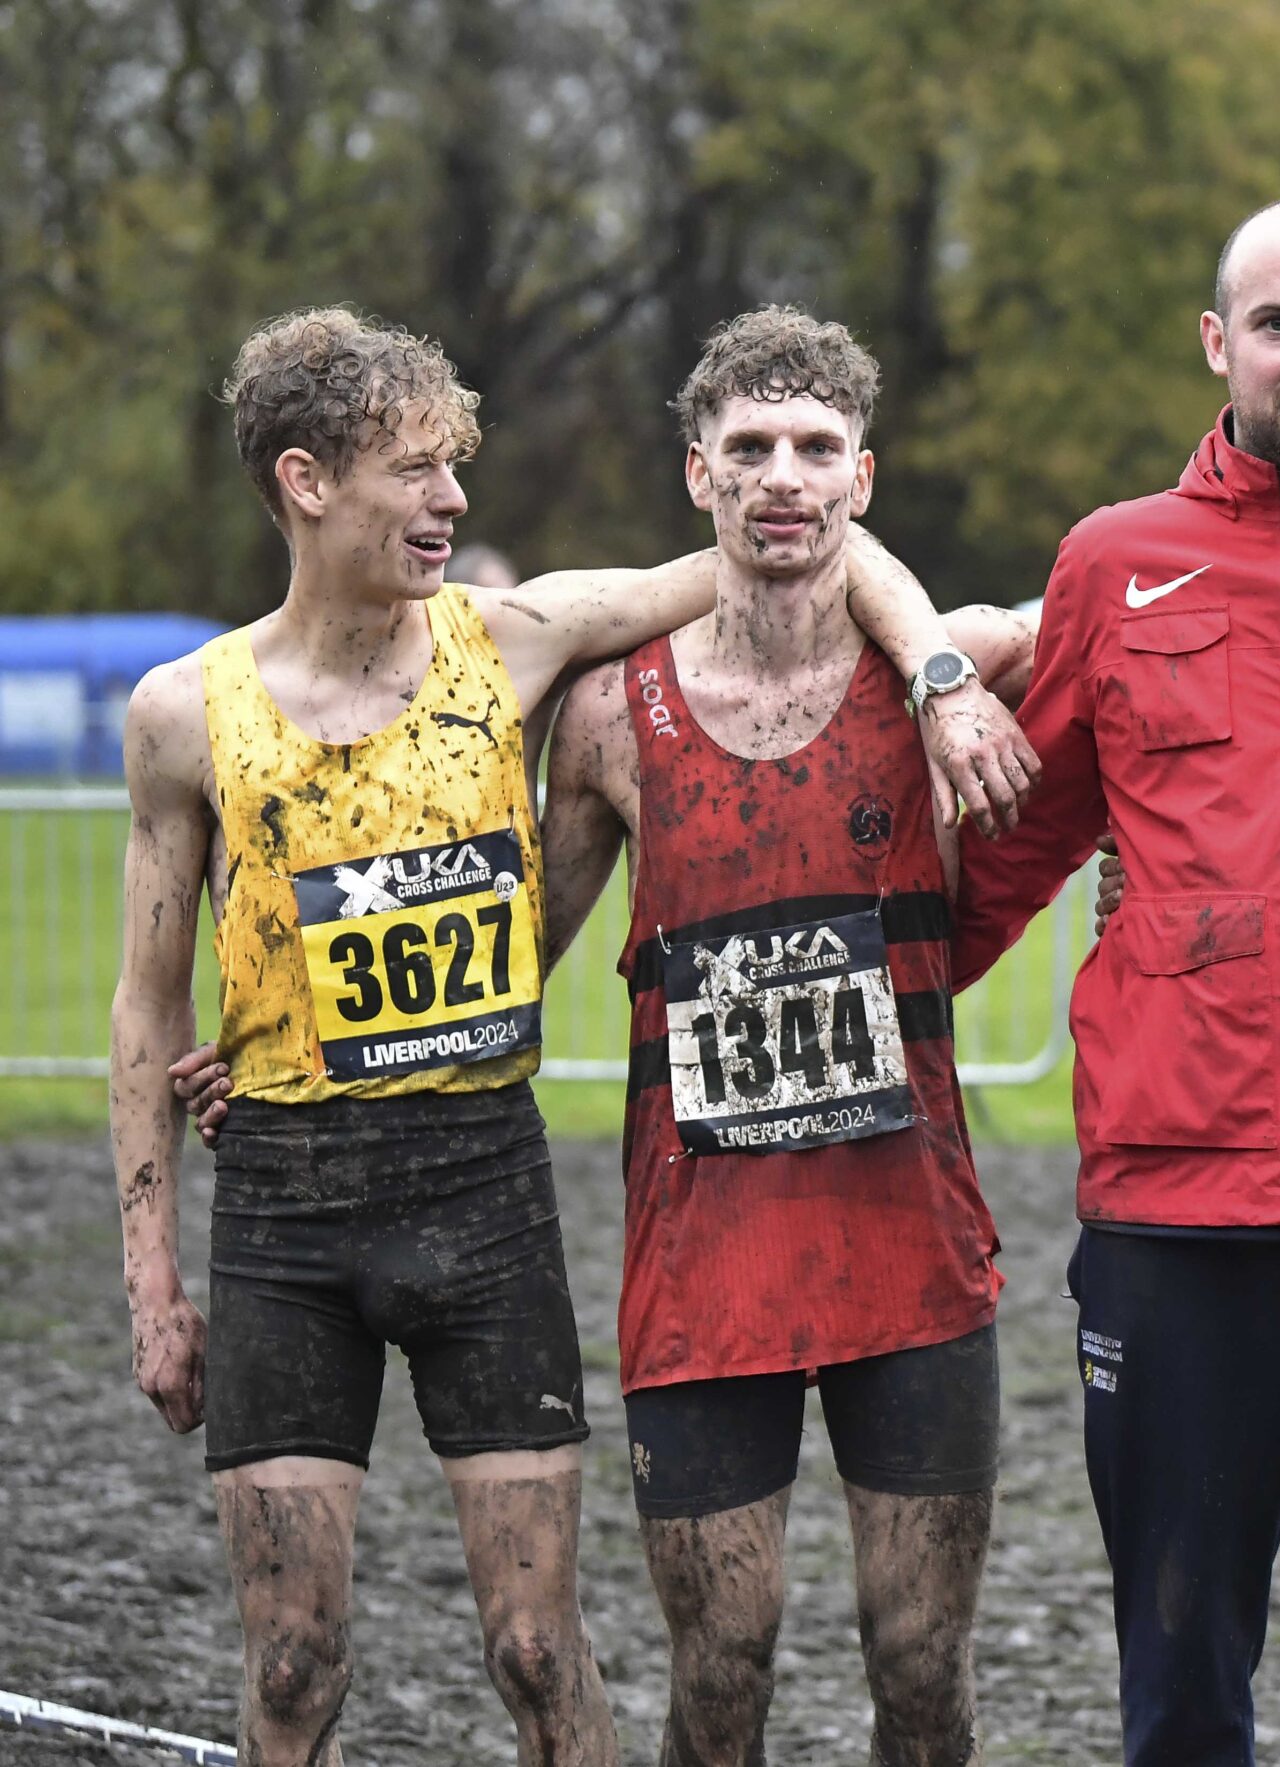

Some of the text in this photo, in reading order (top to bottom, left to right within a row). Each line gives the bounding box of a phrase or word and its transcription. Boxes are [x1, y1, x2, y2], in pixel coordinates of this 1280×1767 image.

[638, 668, 679, 738] soar
[392, 843, 491, 885] UKA
[397, 867, 493, 899] CROSS CHALLENGE
[496, 880, 515, 893] U23
[328, 900, 513, 1023] 3627
[744, 926, 849, 965] UKA
[788, 950, 852, 974] CHALLENGE
[691, 986, 877, 1104] 1344
